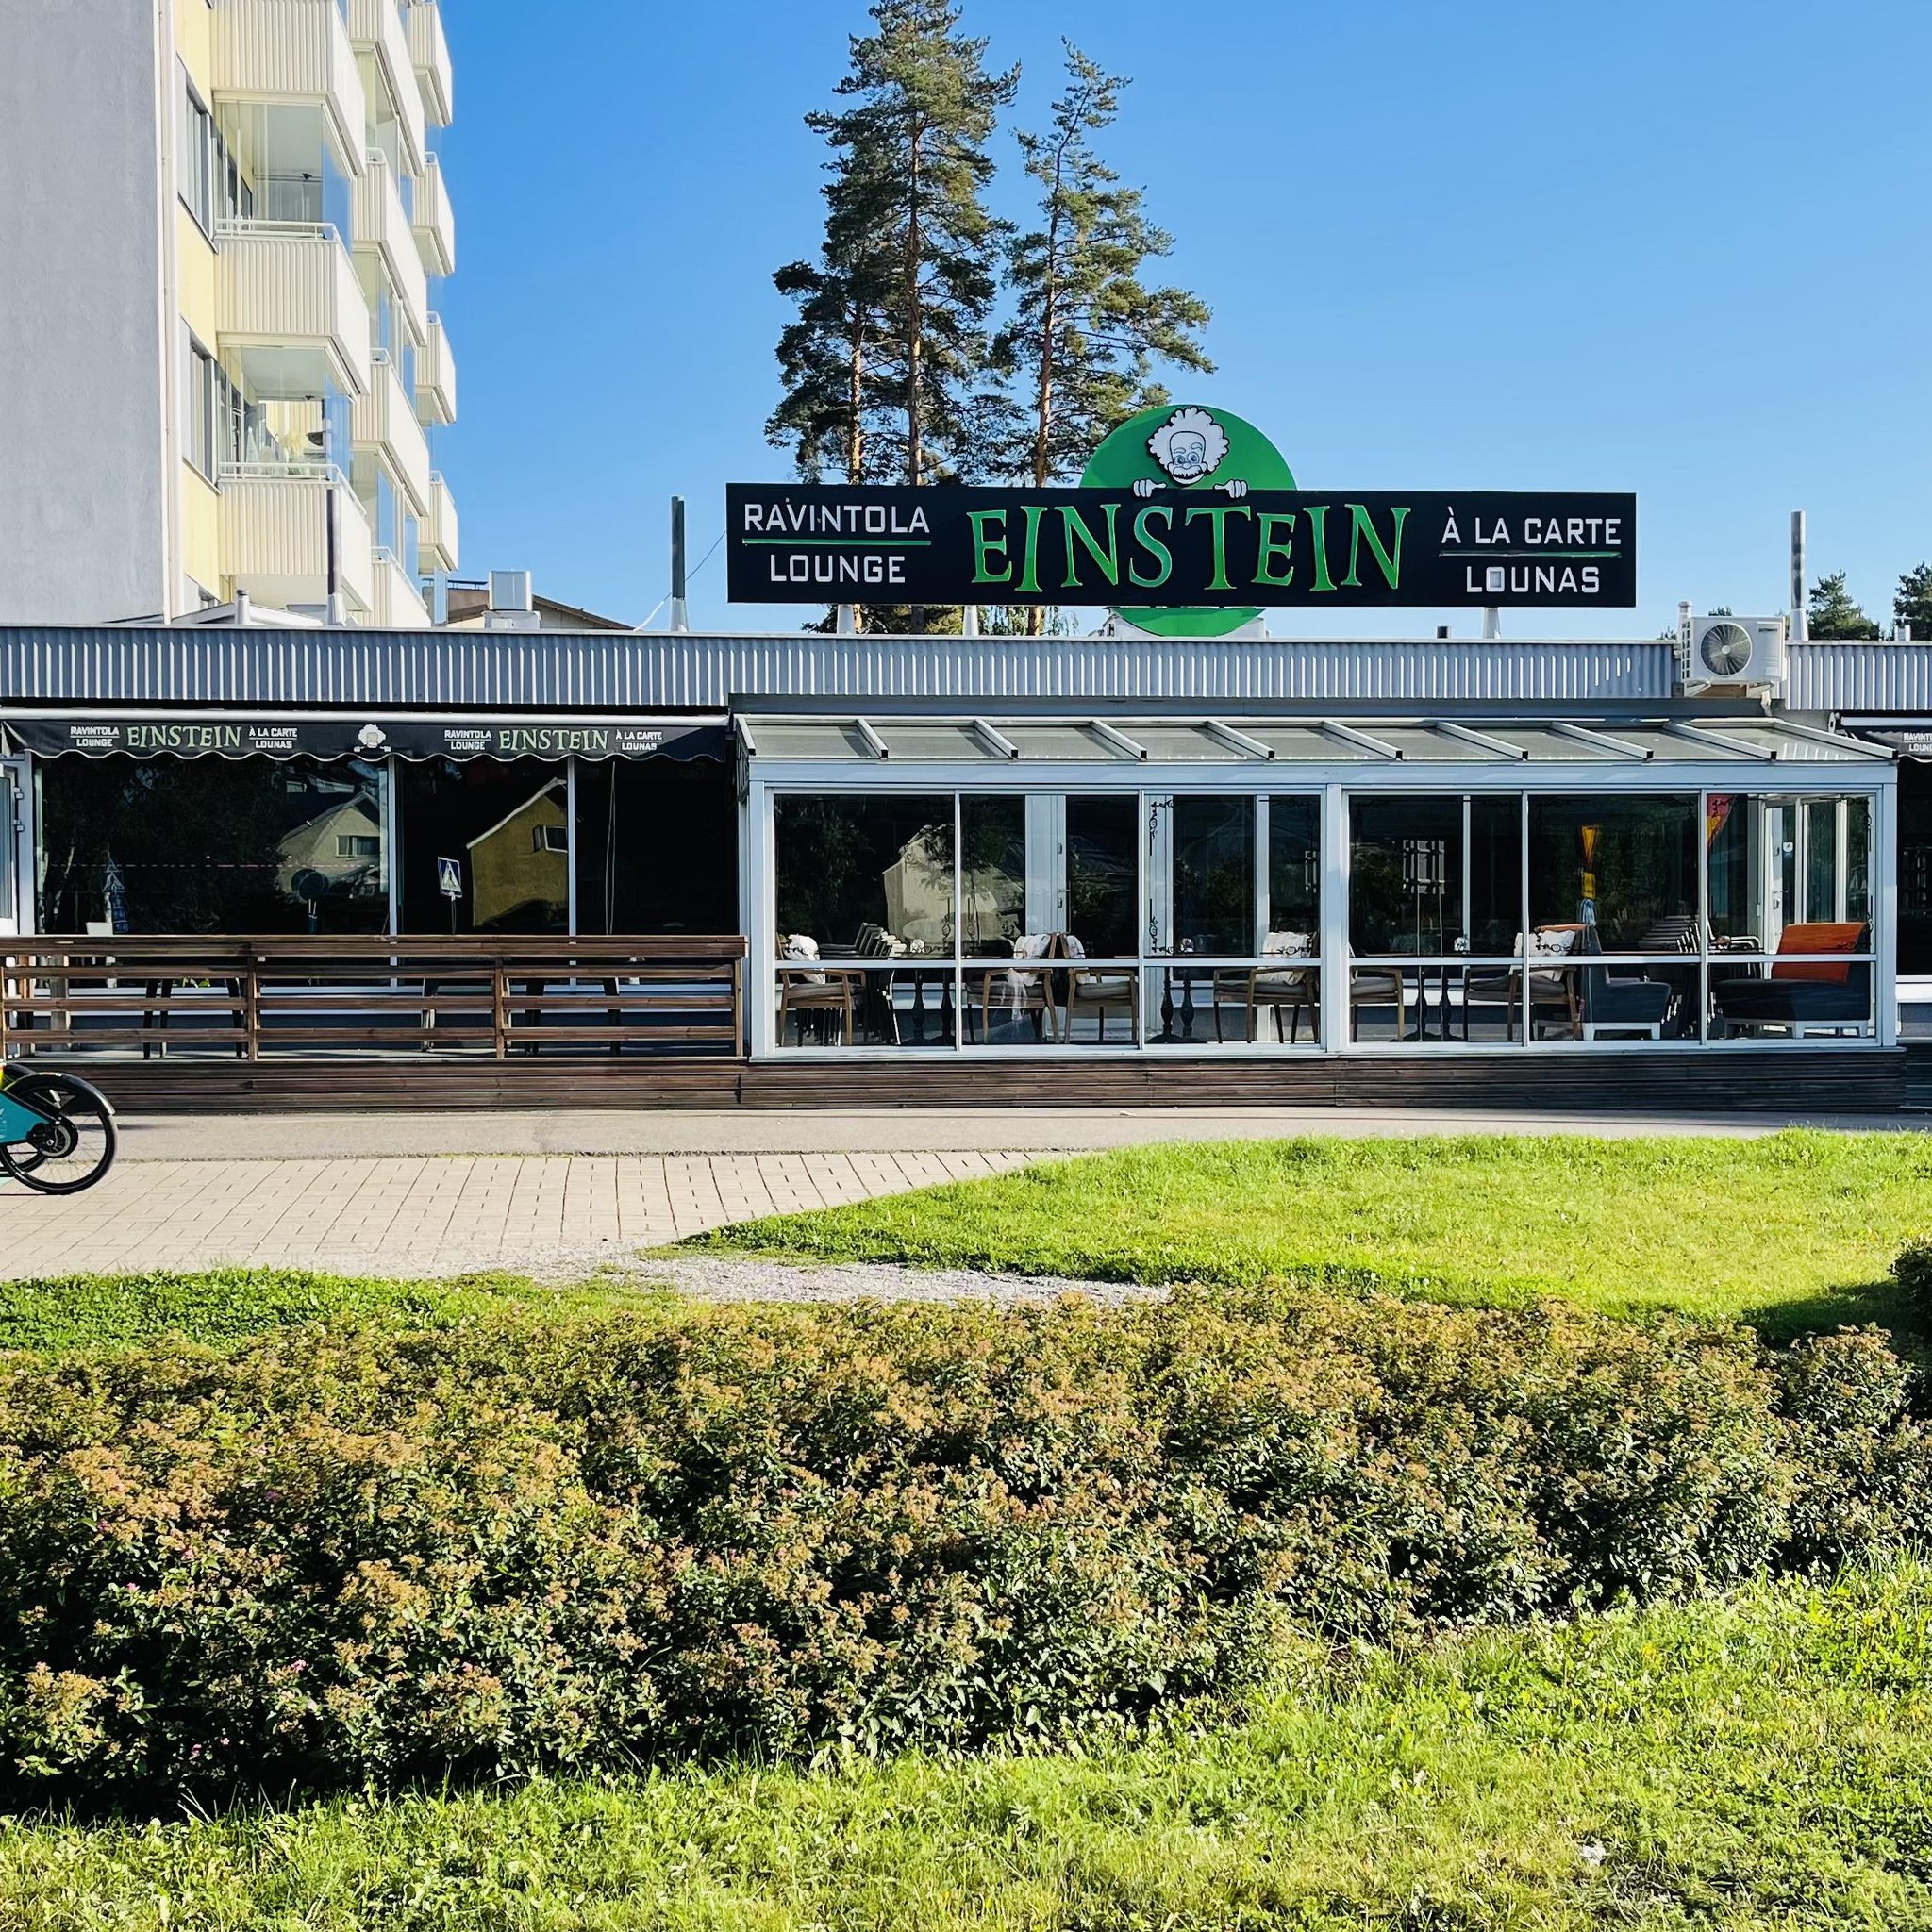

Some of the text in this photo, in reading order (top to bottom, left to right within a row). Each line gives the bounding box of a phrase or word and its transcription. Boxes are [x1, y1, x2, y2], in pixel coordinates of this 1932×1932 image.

[743, 503, 931, 534] RAVINTOLA
[1441, 507, 1622, 545] À LA CARTE
[966, 503, 1411, 593] EINSTEIN
[770, 554, 906, 583] LOUNGE
[1466, 566, 1600, 593] LOUNAS
[70, 725, 120, 736] RAVINTOLA
[126, 724, 242, 748] EINSTEIN
[248, 725, 298, 738] À LA CARTE
[443, 729, 492, 739] RAVINTOLA
[624, 731, 635, 740] LA
[636, 731, 662, 741] CARTE
[76, 738, 113, 747] LOUNGE
[255, 740, 293, 749] LOUNAS
[450, 741, 486, 750] LOUNGE
[498, 728, 609, 751] EINSTEIN
[621, 742, 658, 751] LOUNAS
